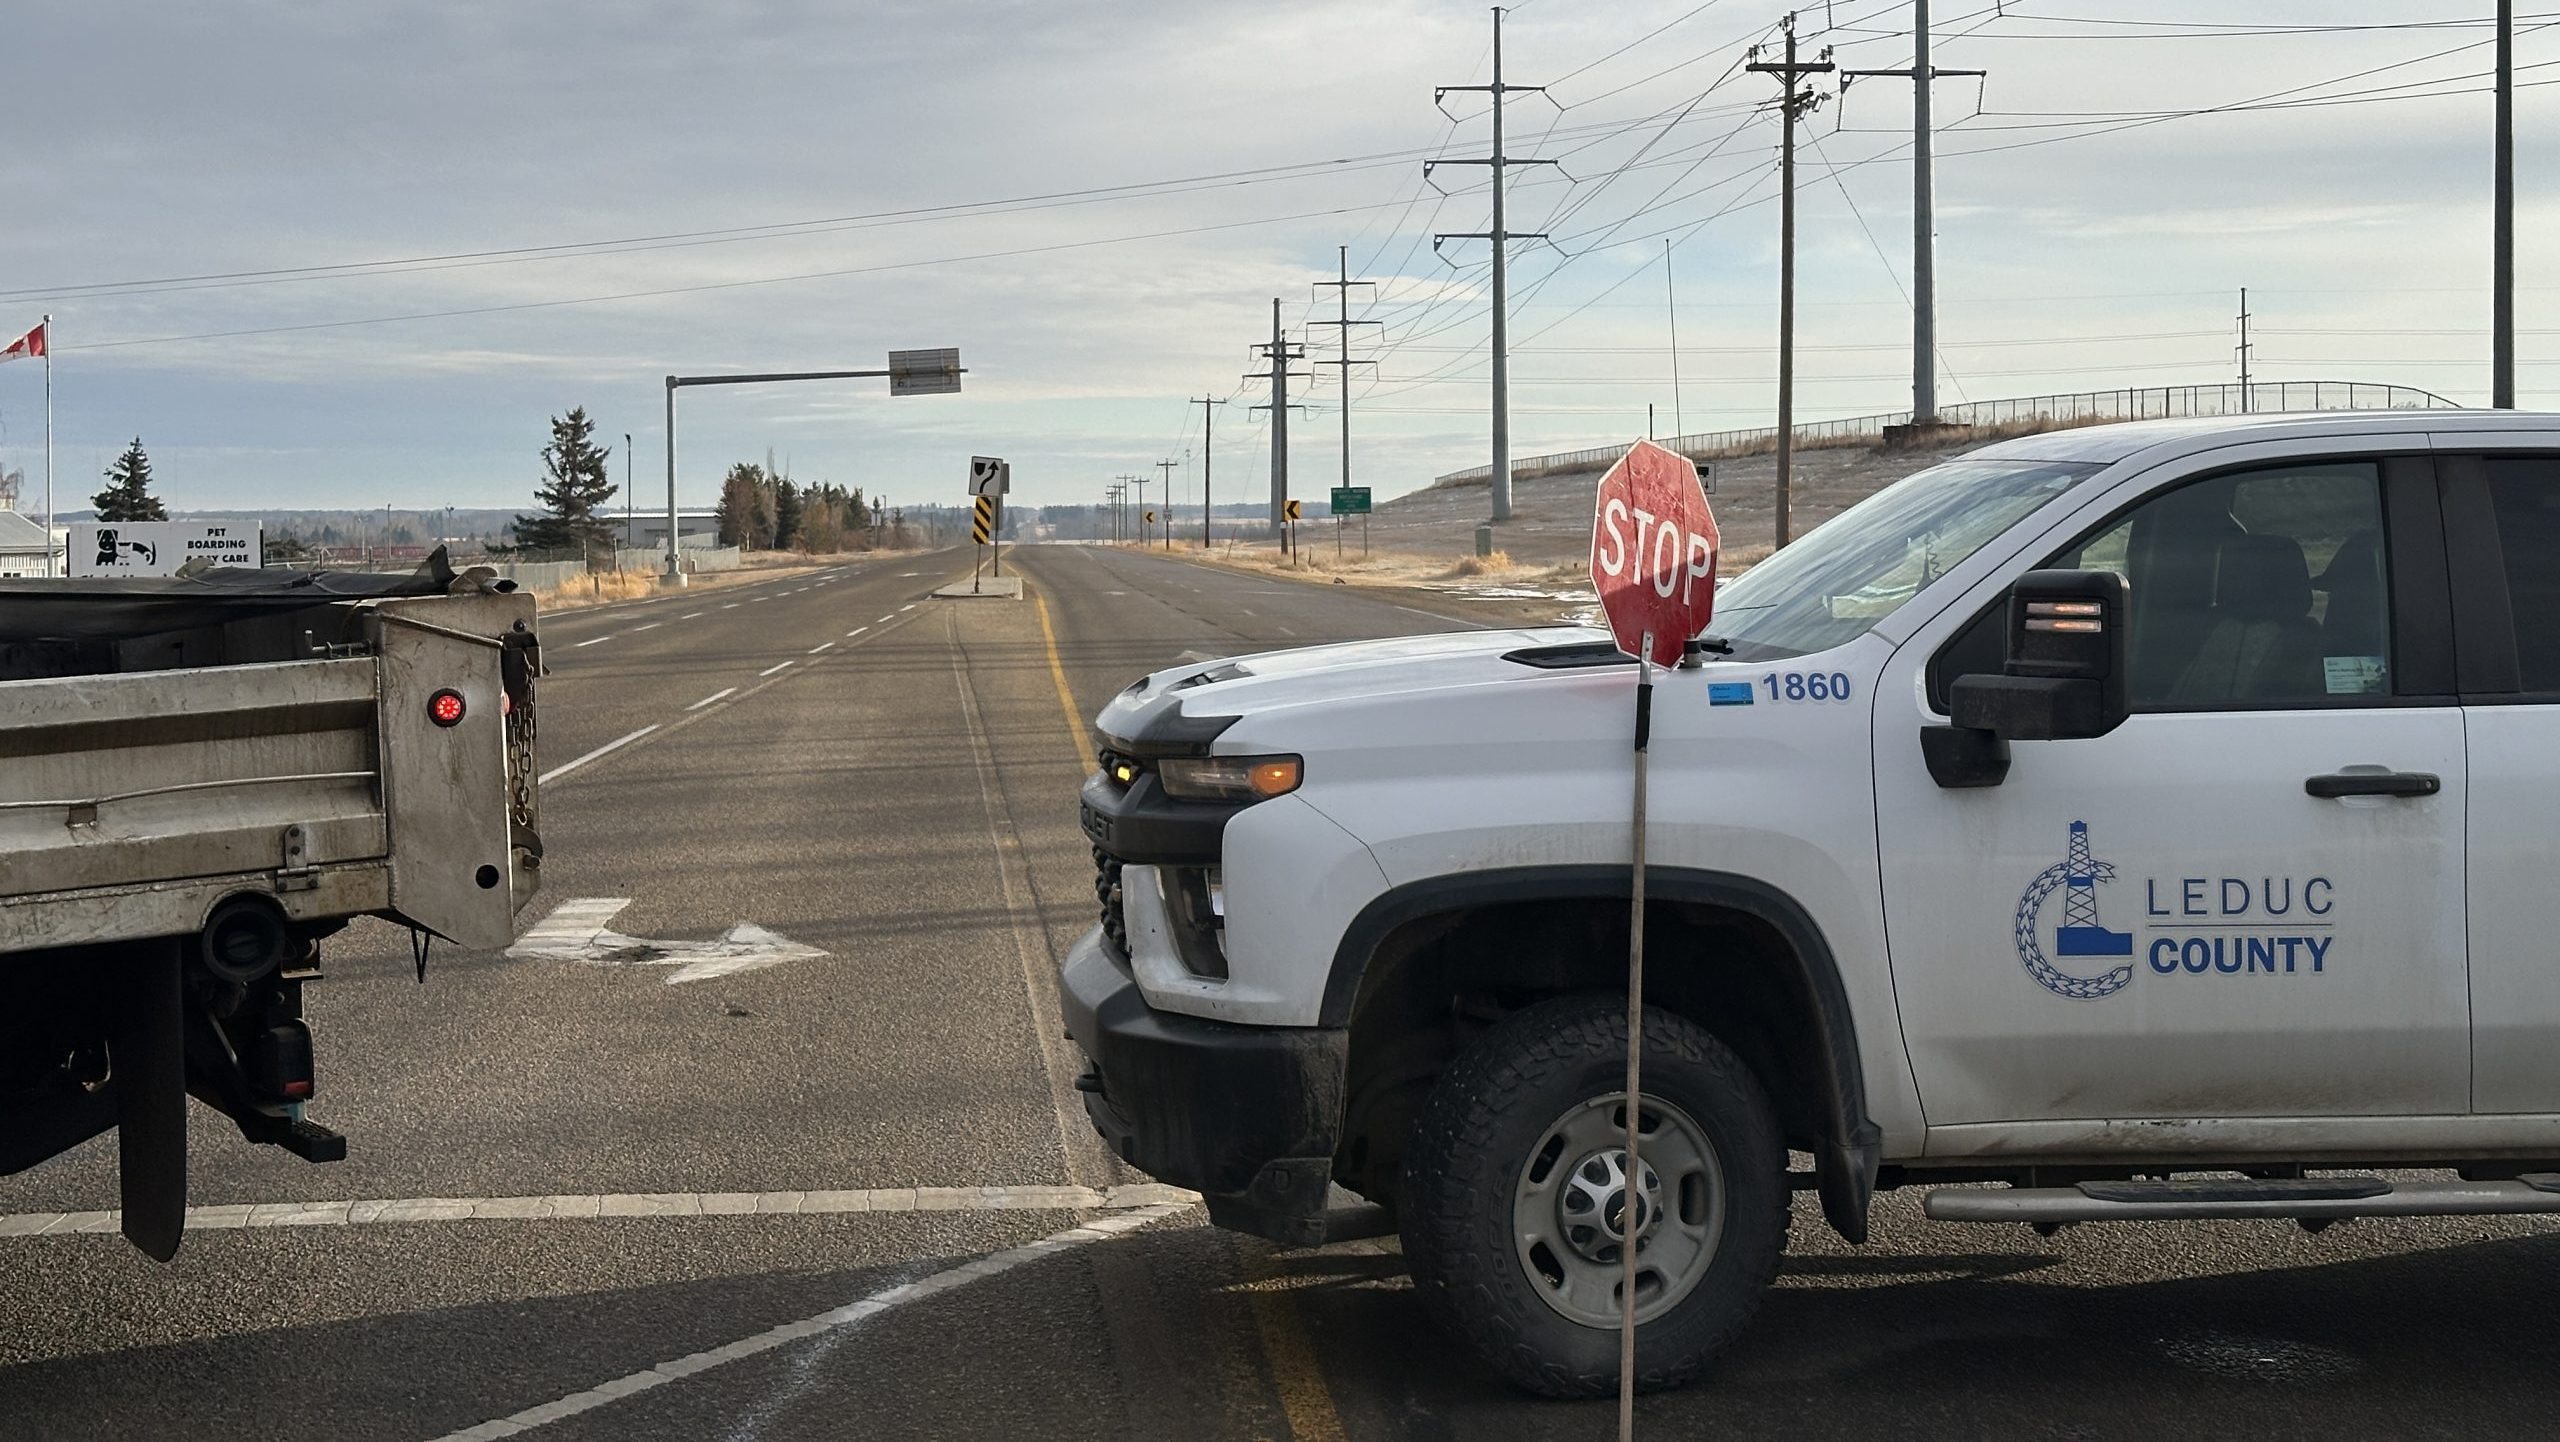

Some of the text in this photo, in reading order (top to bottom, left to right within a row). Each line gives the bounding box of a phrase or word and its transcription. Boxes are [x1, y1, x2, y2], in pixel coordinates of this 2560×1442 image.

[187, 540, 246, 549] BOARDING
[207, 528, 226, 537] PET
[222, 554, 249, 563] CARE
[1600, 498, 1711, 606] STOP
[1763, 672, 1851, 701] 1860
[2148, 876, 2333, 916] LEDUC
[2149, 936, 2333, 974] COUNTY
